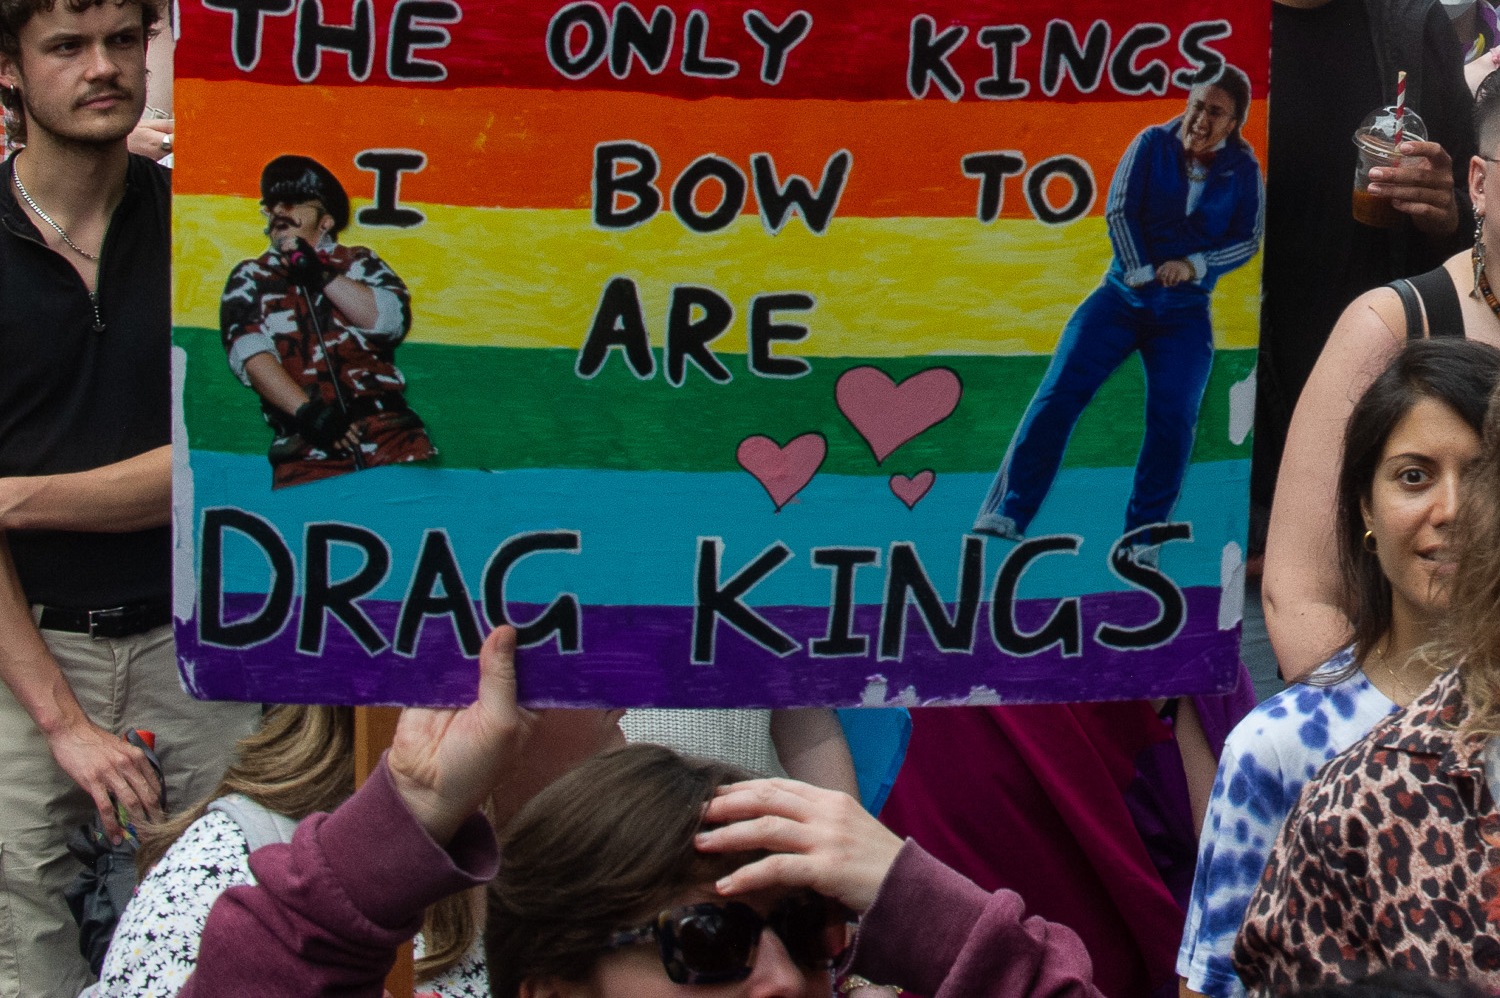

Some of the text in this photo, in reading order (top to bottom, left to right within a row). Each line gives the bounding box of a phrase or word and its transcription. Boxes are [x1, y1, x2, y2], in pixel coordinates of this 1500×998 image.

[545, 0, 813, 85] ONLY
[906, 13, 1233, 103] KINGS
[353, 139, 1098, 238] I BOW TO
[575, 274, 817, 388] ARE
[198, 506, 1195, 665] DRAG KINGS
